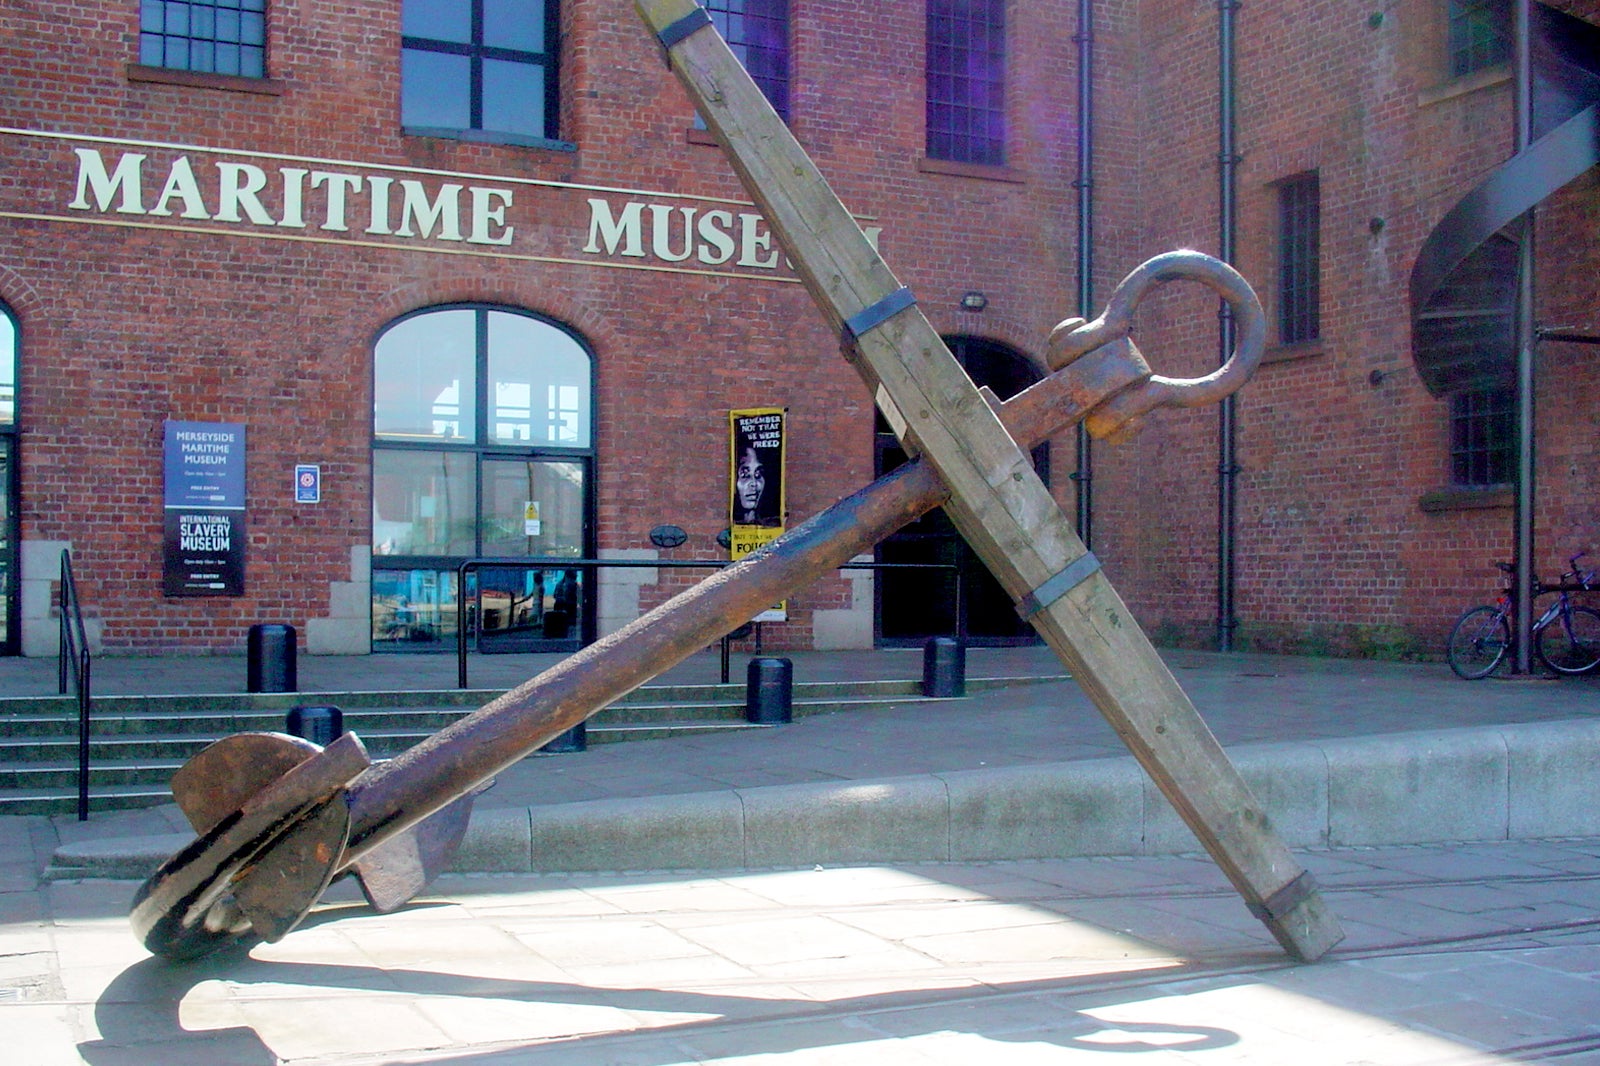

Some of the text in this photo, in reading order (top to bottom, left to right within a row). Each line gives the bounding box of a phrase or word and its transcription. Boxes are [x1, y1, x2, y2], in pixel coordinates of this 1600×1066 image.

[68, 148, 883, 271] MARITIME MUSE
[740, 416, 781, 425] REMEMBER
[759, 423, 780, 431] THAT
[176, 431, 235, 442] MERSEYSIDE
[747, 431, 781, 440] WE WERE
[181, 443, 230, 454] MARITIME
[753, 440, 780, 448] FREED
[184, 455, 227, 465] MUSEUM
[179, 515, 230, 524] INTERNATIONAL
[180, 524, 230, 537] SLAVERY
[180, 536, 231, 551] MUSEUM
